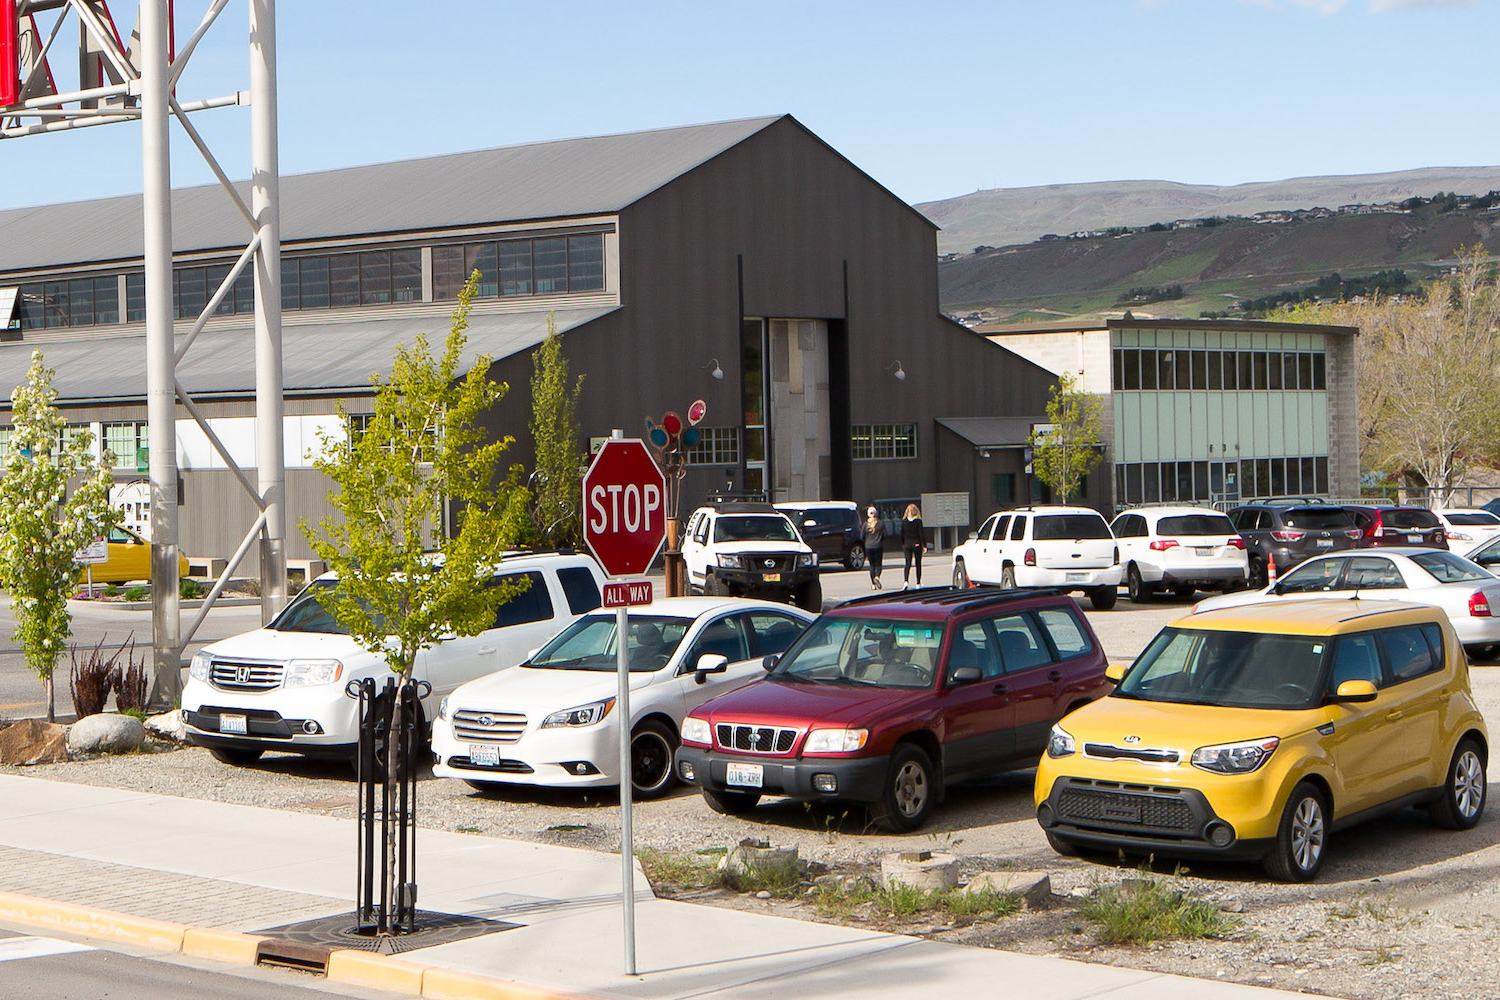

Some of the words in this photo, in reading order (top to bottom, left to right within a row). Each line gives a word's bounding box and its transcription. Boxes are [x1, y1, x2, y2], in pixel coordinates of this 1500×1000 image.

[727, 481, 733, 491] 7
[590, 483, 661, 535] STOP
[606, 587, 625, 604] ALL
[629, 585, 650, 602] WAY
[1124, 735, 1141, 745] KIA
